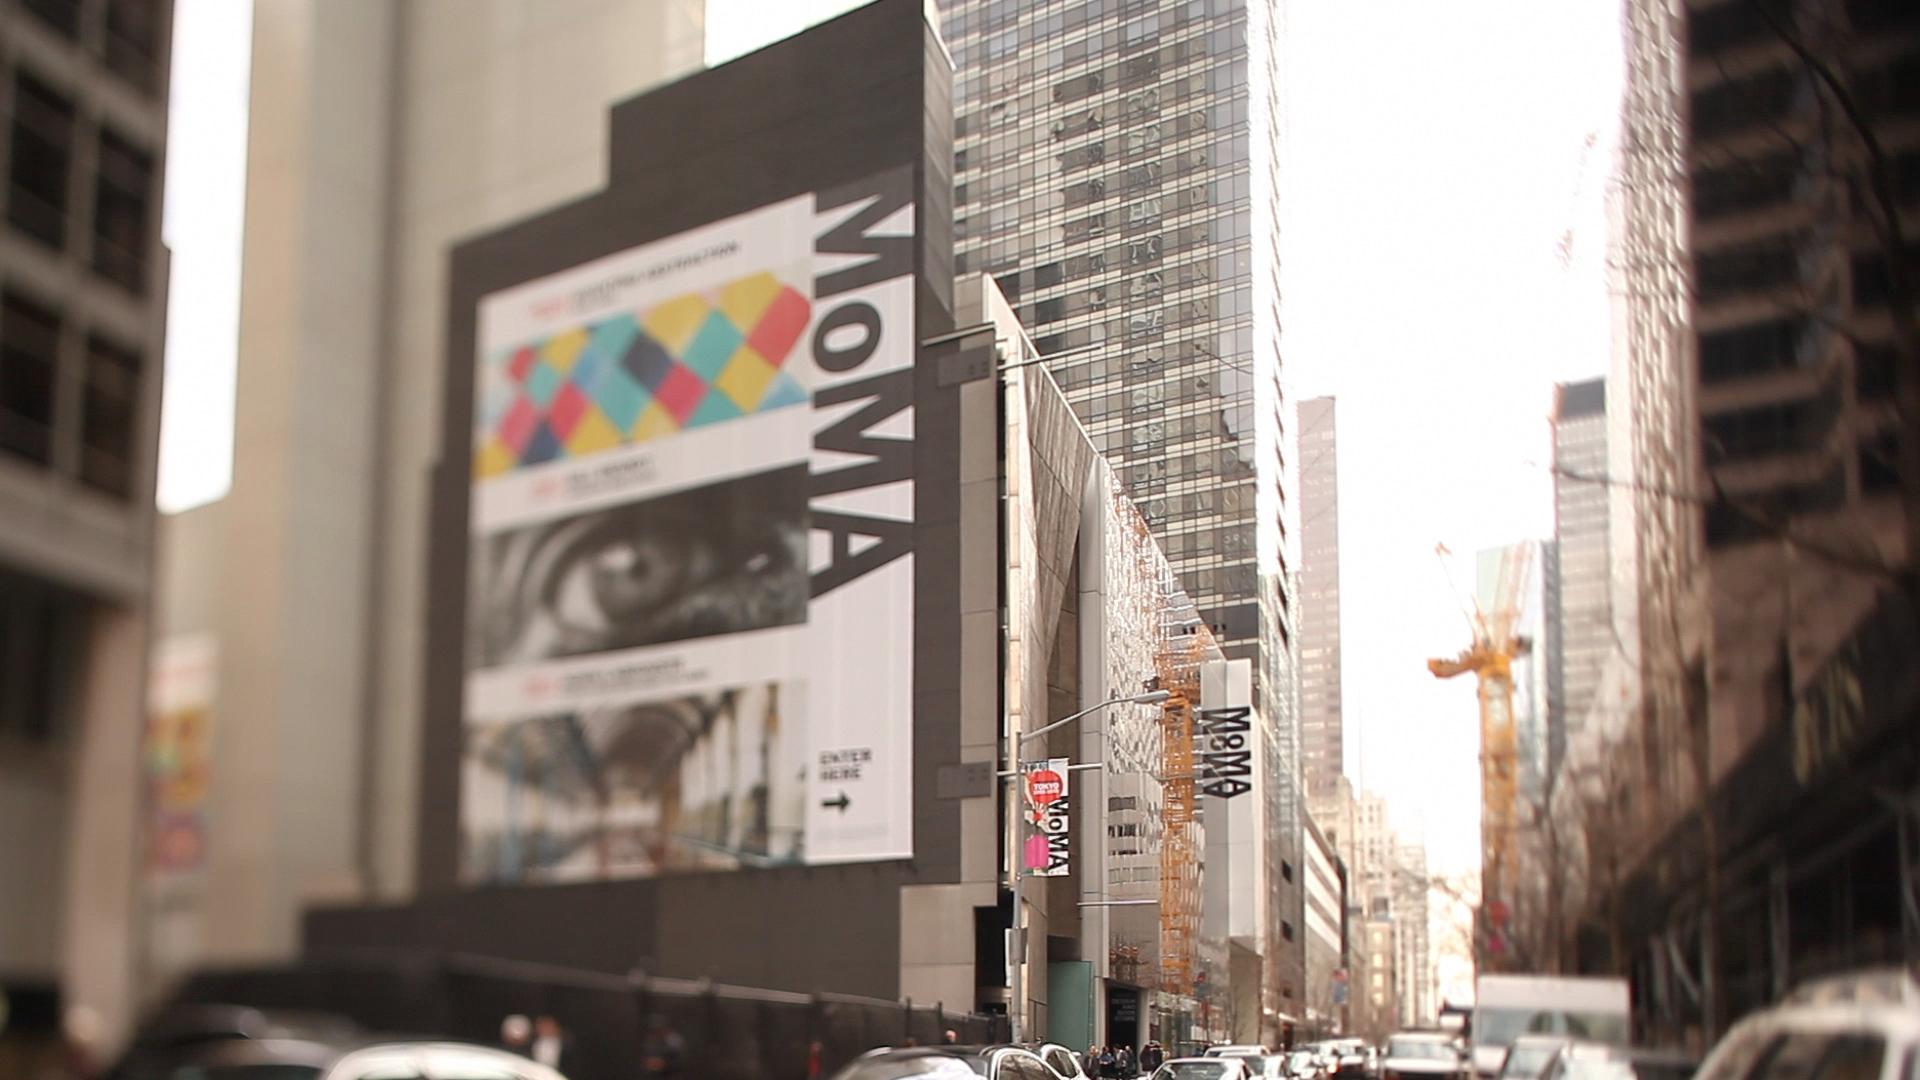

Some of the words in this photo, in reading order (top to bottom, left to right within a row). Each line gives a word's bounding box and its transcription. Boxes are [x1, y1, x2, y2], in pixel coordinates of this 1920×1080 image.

[820, 748, 871, 764] ENTER
[1226, 706, 1251, 798] MoMA
[820, 767, 861, 781] HERE
